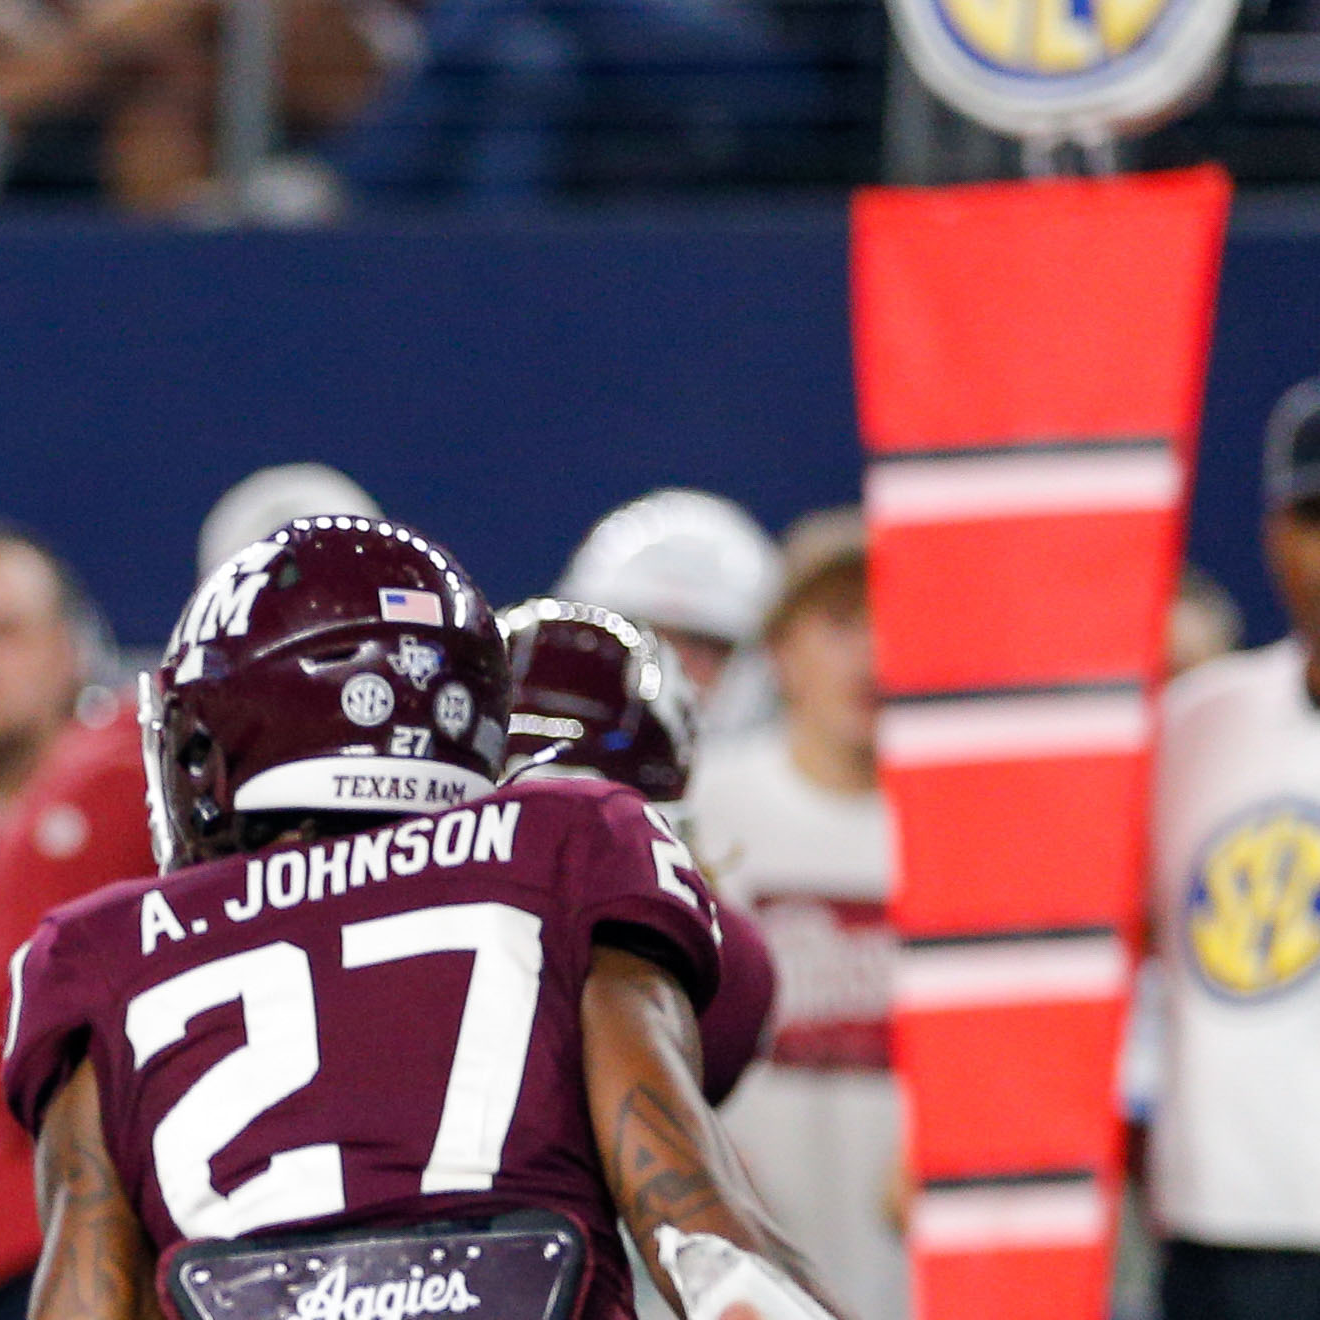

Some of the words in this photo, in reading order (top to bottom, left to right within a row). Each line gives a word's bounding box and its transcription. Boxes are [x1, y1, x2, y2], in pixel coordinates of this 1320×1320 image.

[333, 775, 417, 800] TEXAS
[390, 725, 432, 758] 27
[140, 889, 208, 955] A.
[224, 802, 521, 922] JOHNSON
[124, 901, 543, 1240] 27
